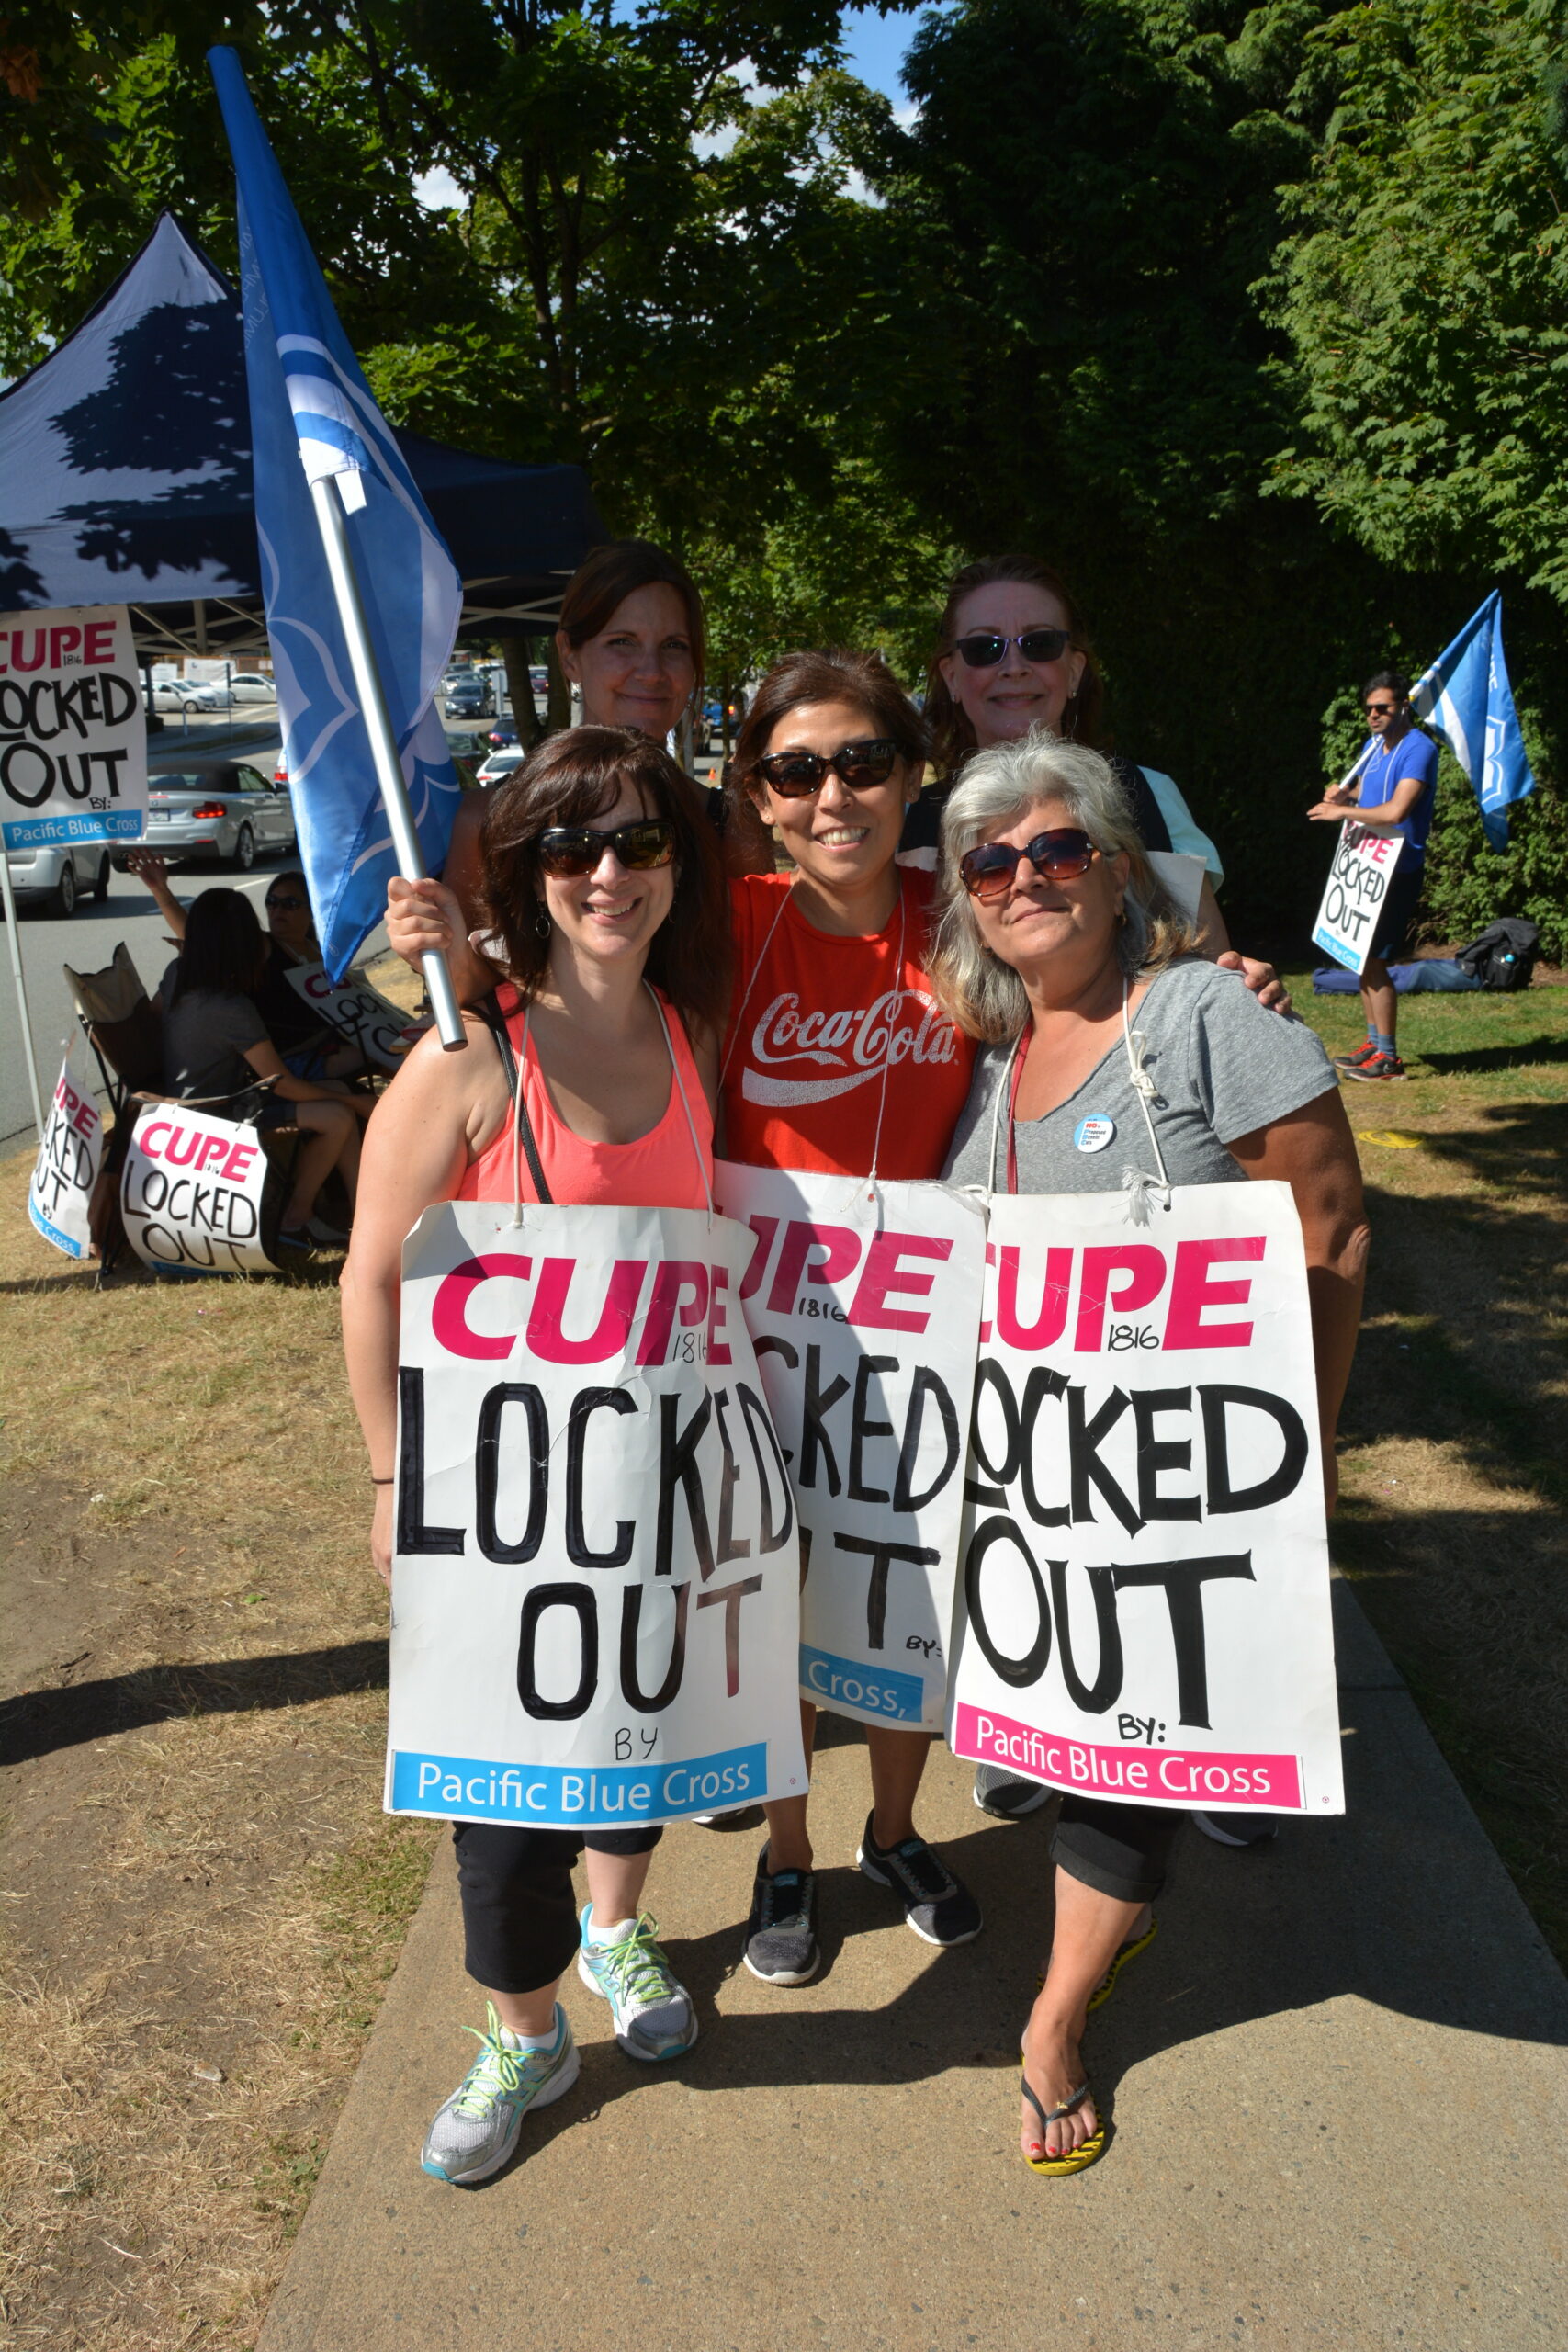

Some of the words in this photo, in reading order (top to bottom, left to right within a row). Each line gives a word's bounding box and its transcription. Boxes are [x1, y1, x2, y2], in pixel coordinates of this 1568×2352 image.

[63, 654, 83, 667] 1816
[0, 672, 137, 741] OCKED
[0, 741, 128, 808] OUT
[12, 820, 64, 842] Pacific
[68, 817, 103, 836] Blue
[106, 816, 139, 832] Cross
[1332, 838, 1385, 905] LOCKED
[1325, 883, 1371, 942] OUT
[751, 989, 956, 1067] Coca-Cola
[140, 1121, 259, 1183] CUPE
[124, 1160, 257, 1238] LOCKED
[142, 1223, 246, 1272] OUT
[432, 1253, 733, 1366] CUPE
[798, 1296, 849, 1324] 1816
[1108, 1324, 1160, 1351] 1816
[397, 1366, 794, 1582] LOCKED
[964, 1358, 1309, 1539] OCKED
[516, 1573, 763, 1721] OUT
[965, 1515, 1257, 1729] OUT
[808, 1659, 908, 1717] Cross,
[615, 1727, 659, 1761] BY
[976, 1715, 1062, 1774] Pacific
[1068, 1745, 1149, 1789] Blue
[1159, 1756, 1271, 1794] Cross
[1118, 1713, 1167, 1745] BY:
[418, 1761, 547, 1811] Pacific
[560, 1773, 650, 1814] Blue
[662, 1761, 750, 1806] Cross
